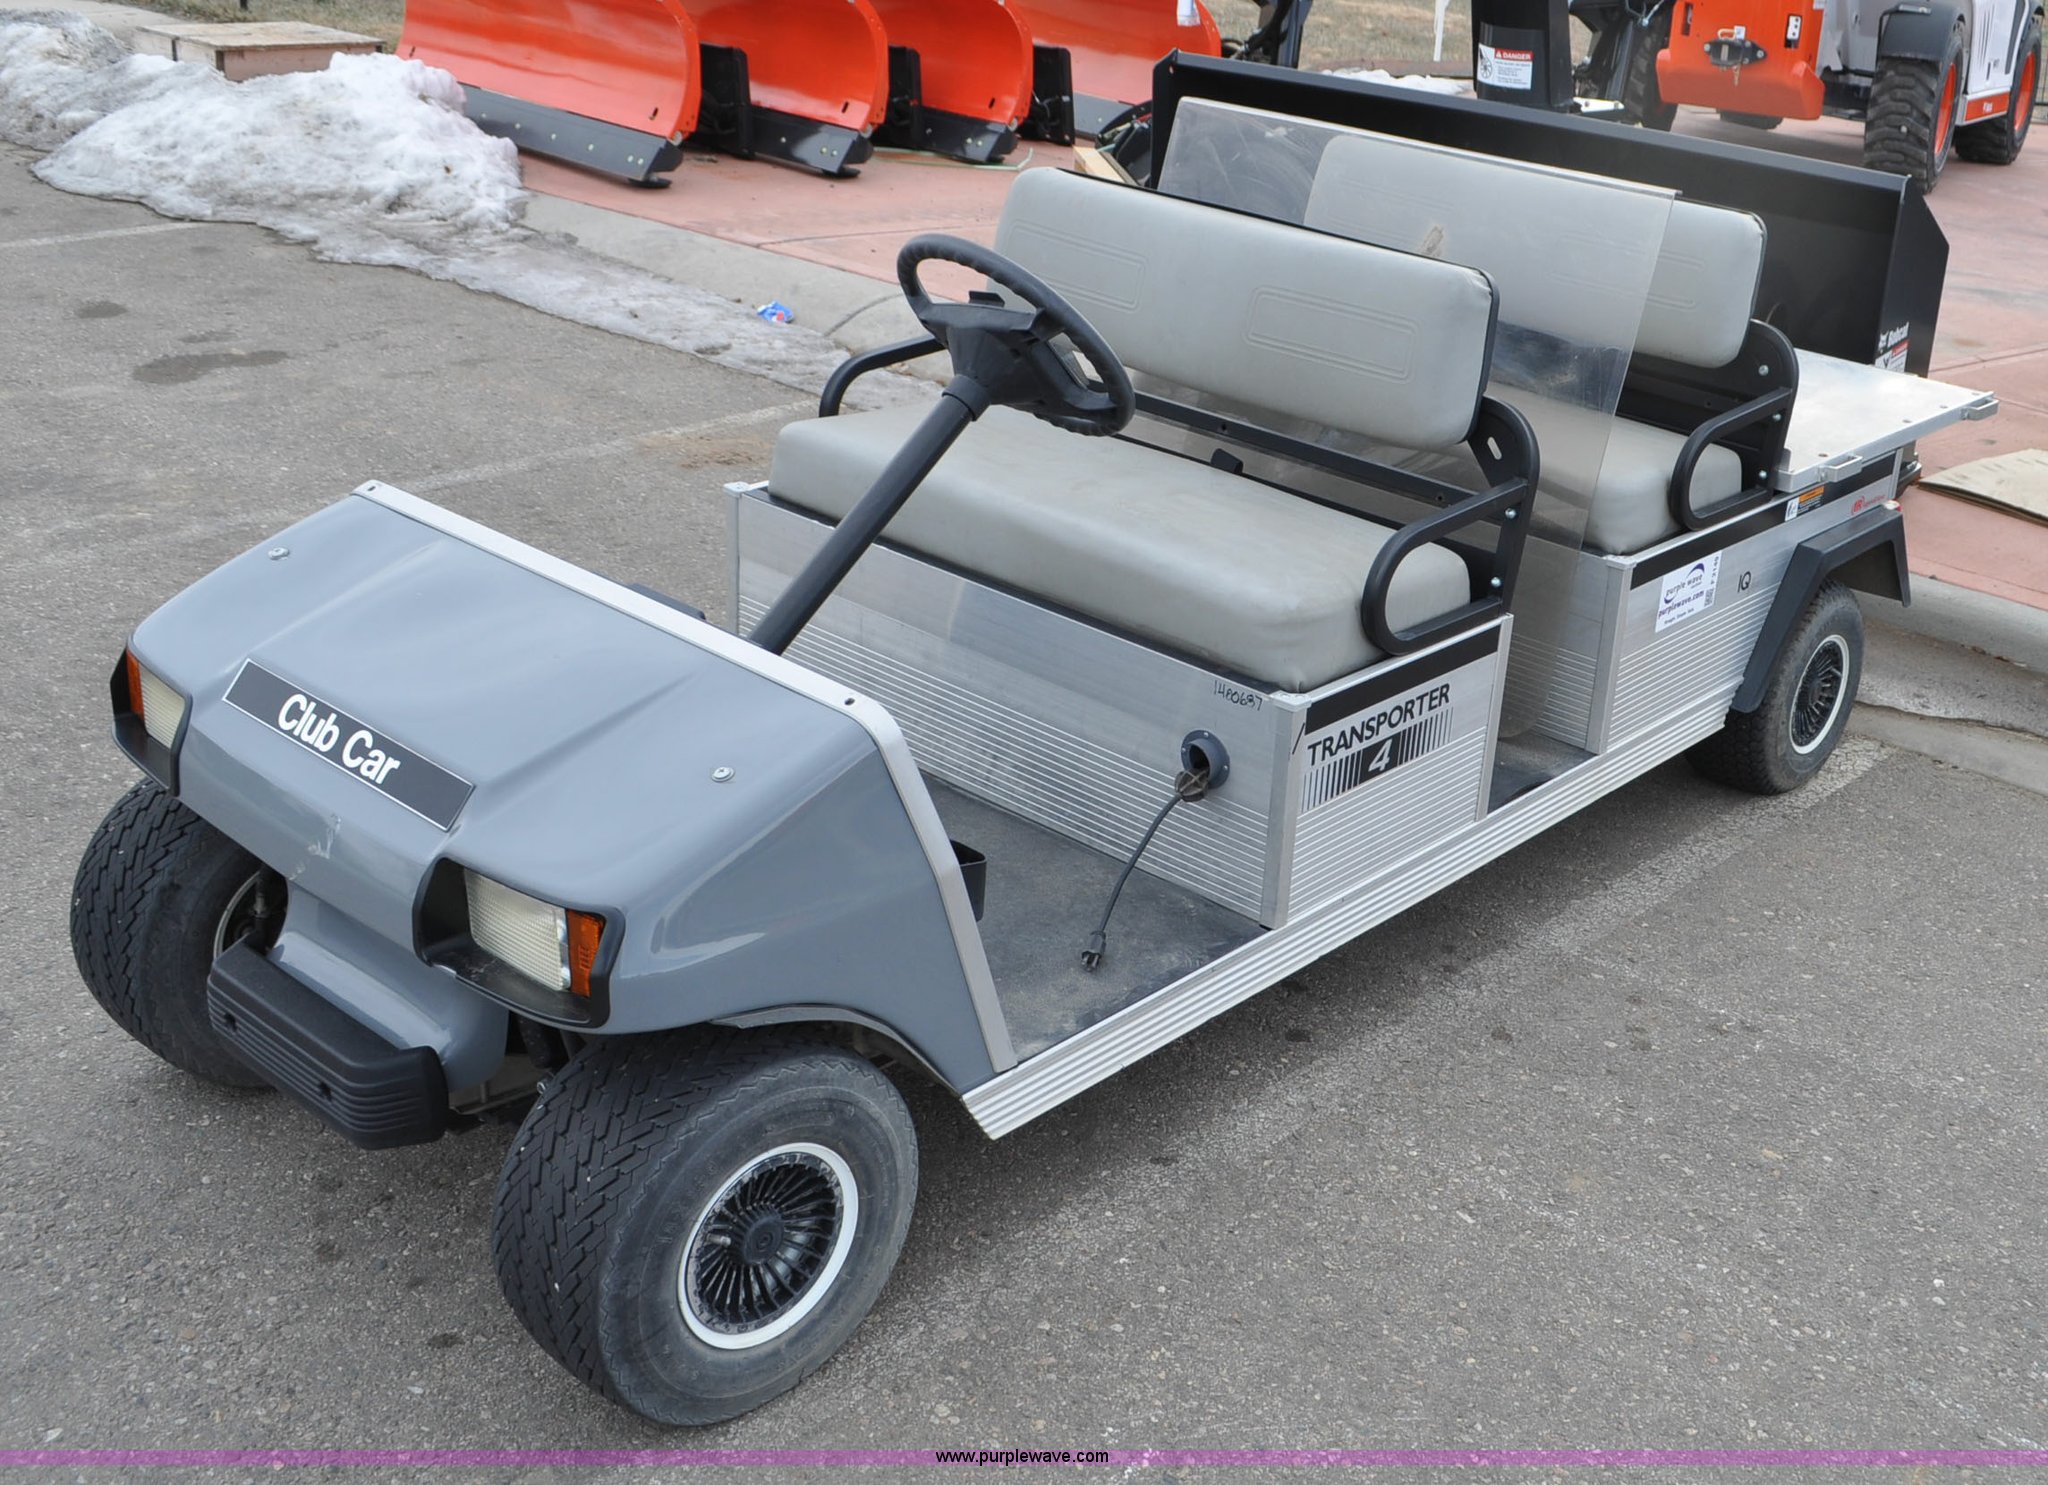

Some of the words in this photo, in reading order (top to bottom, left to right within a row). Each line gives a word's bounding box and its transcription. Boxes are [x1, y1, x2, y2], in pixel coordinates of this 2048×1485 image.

[1665, 581, 1686, 596] purple
[1687, 574, 1703, 585] wave
[1658, 590, 1705, 619] purplewave.com
[278, 694, 340, 752] Club
[342, 730, 401, 784] Car
[1308, 683, 1450, 766] TRANSPORTER
[1368, 738, 1393, 772] 4
